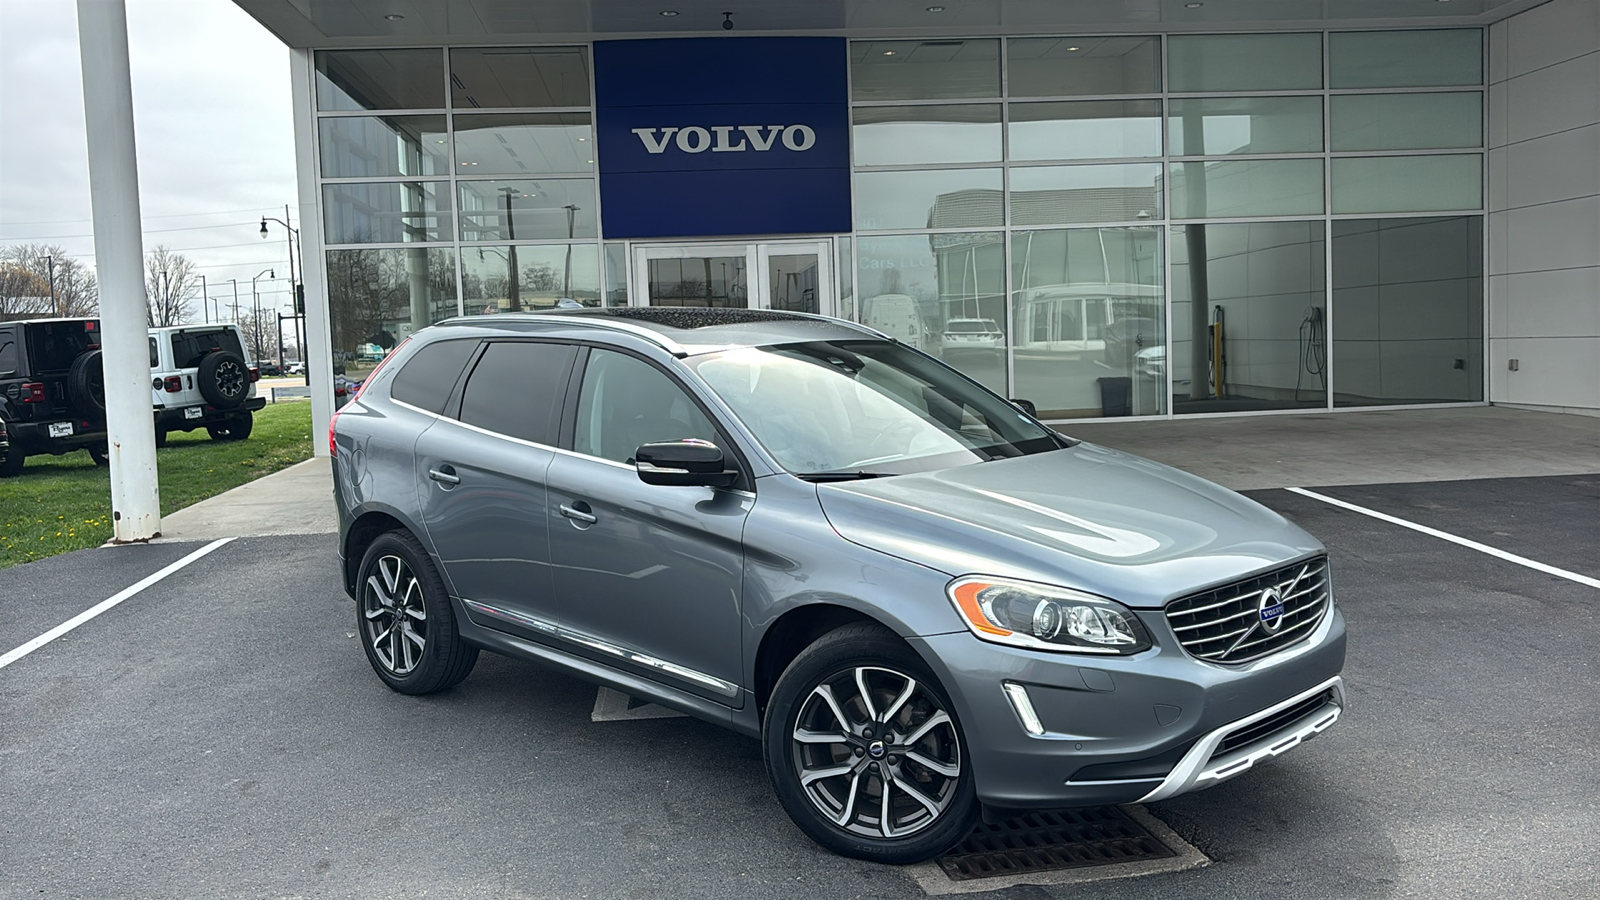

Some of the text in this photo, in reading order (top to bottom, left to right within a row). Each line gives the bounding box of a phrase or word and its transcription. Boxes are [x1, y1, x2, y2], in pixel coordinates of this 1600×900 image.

[631, 124, 816, 154] VOLVO
[859, 255, 930, 270] Cars LLC
[1263, 606, 1283, 618] VOLVO
